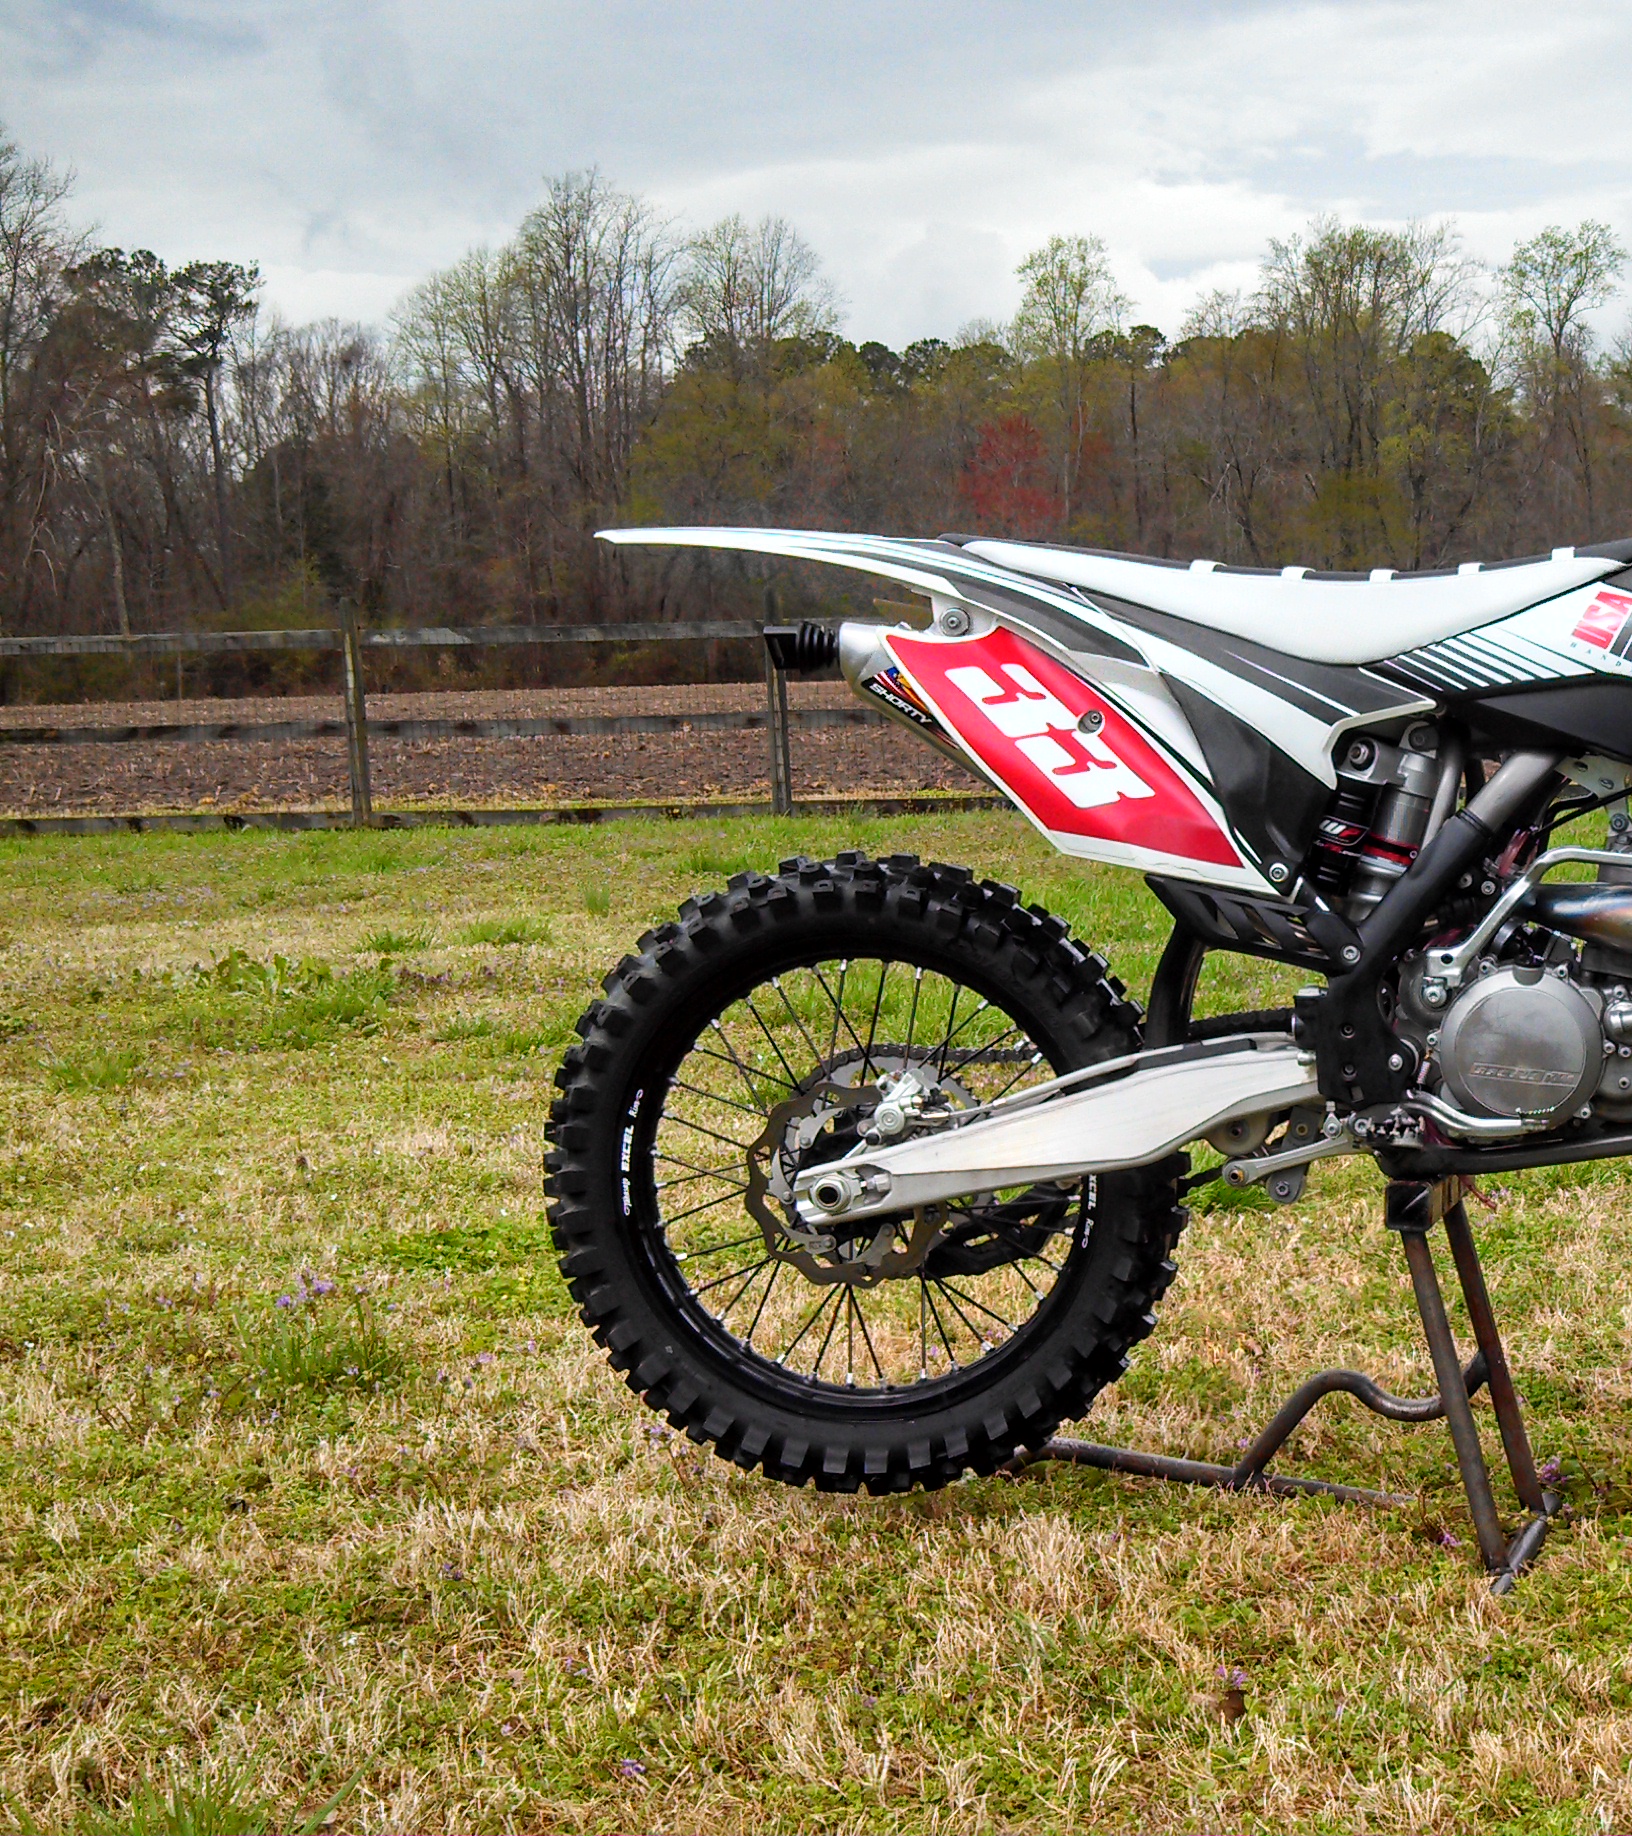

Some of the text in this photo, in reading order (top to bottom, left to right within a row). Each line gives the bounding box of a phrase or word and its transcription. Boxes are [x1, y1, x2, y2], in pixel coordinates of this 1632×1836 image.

[869, 682, 933, 724] SHORTY
[944, 663, 1156, 809] 33
[621, 1124, 634, 1172] EXCEL
[1087, 1174, 1098, 1211] XCEL
